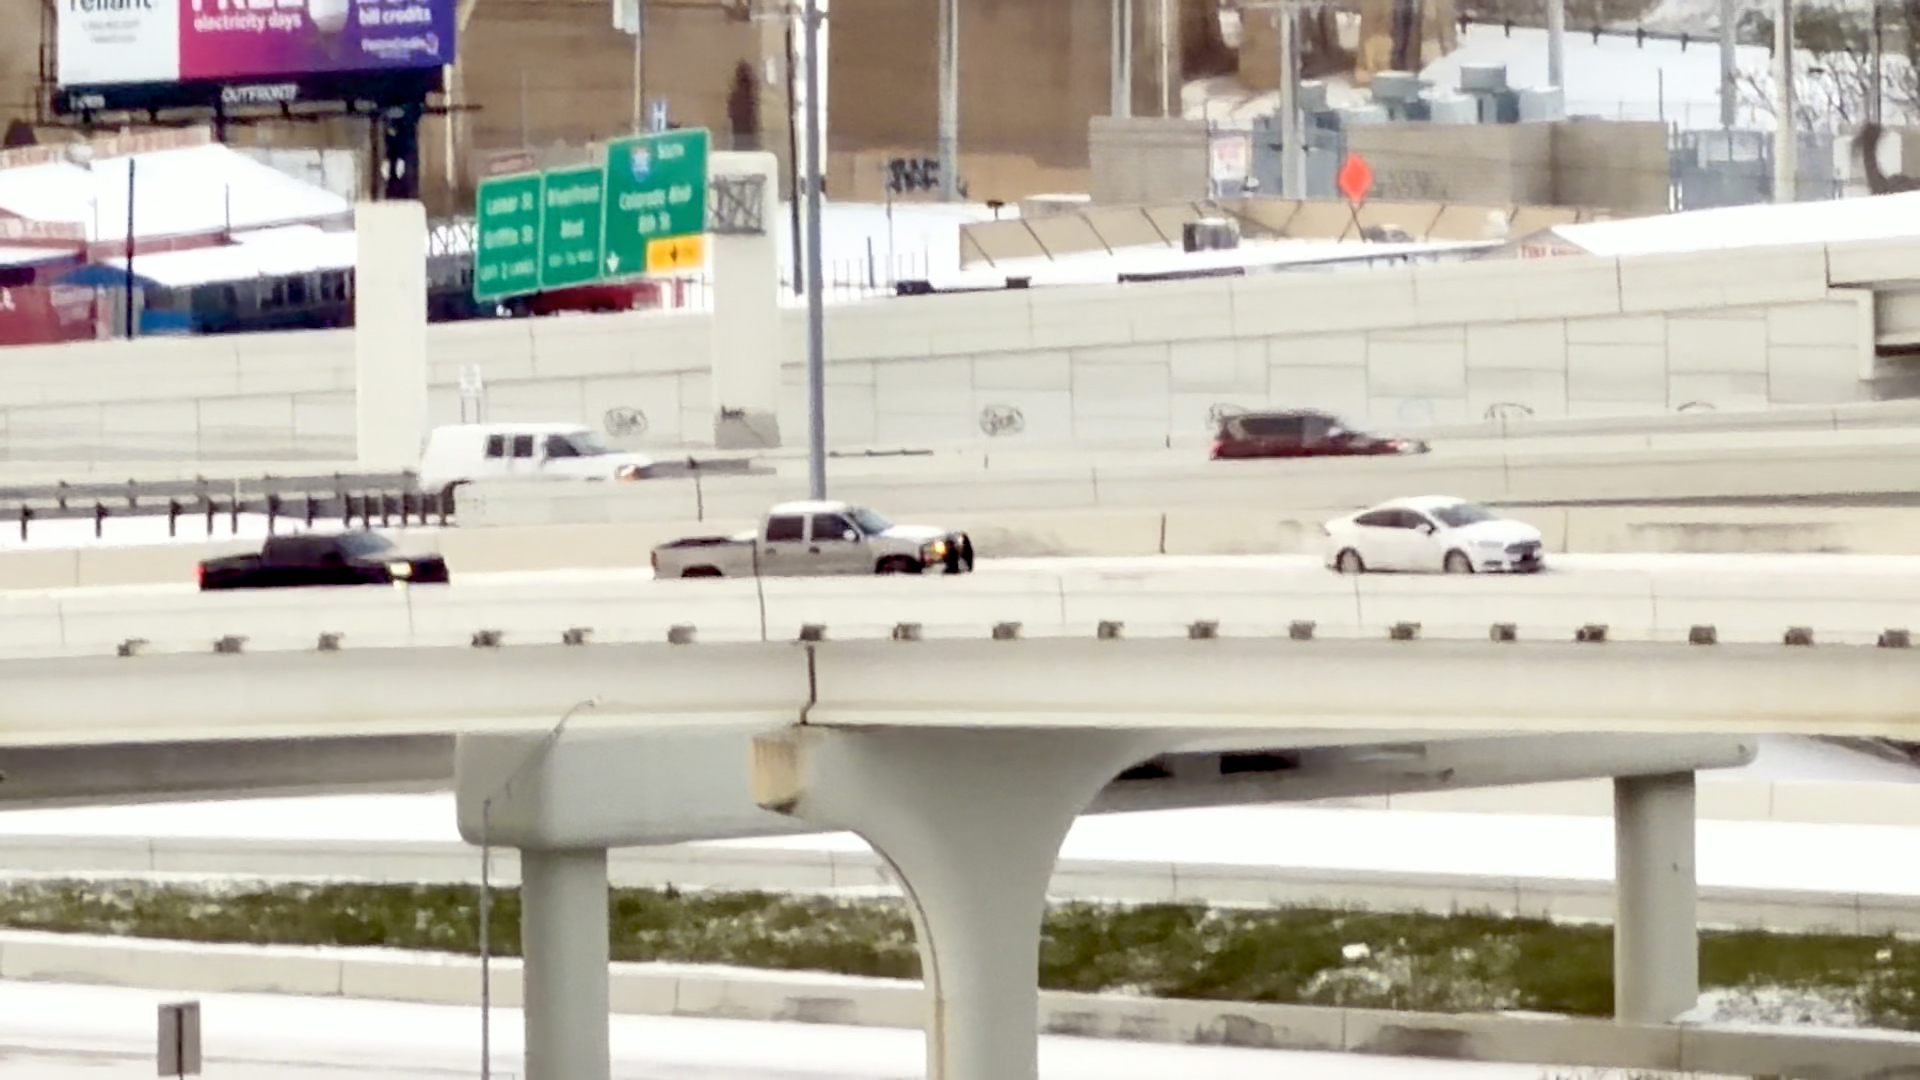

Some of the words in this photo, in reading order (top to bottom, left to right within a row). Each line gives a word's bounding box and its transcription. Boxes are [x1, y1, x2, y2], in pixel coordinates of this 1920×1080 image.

[193, 14, 265, 35] electricity
[267, 11, 302, 33] days
[358, 7, 380, 26] bill
[382, 6, 432, 25] credits
